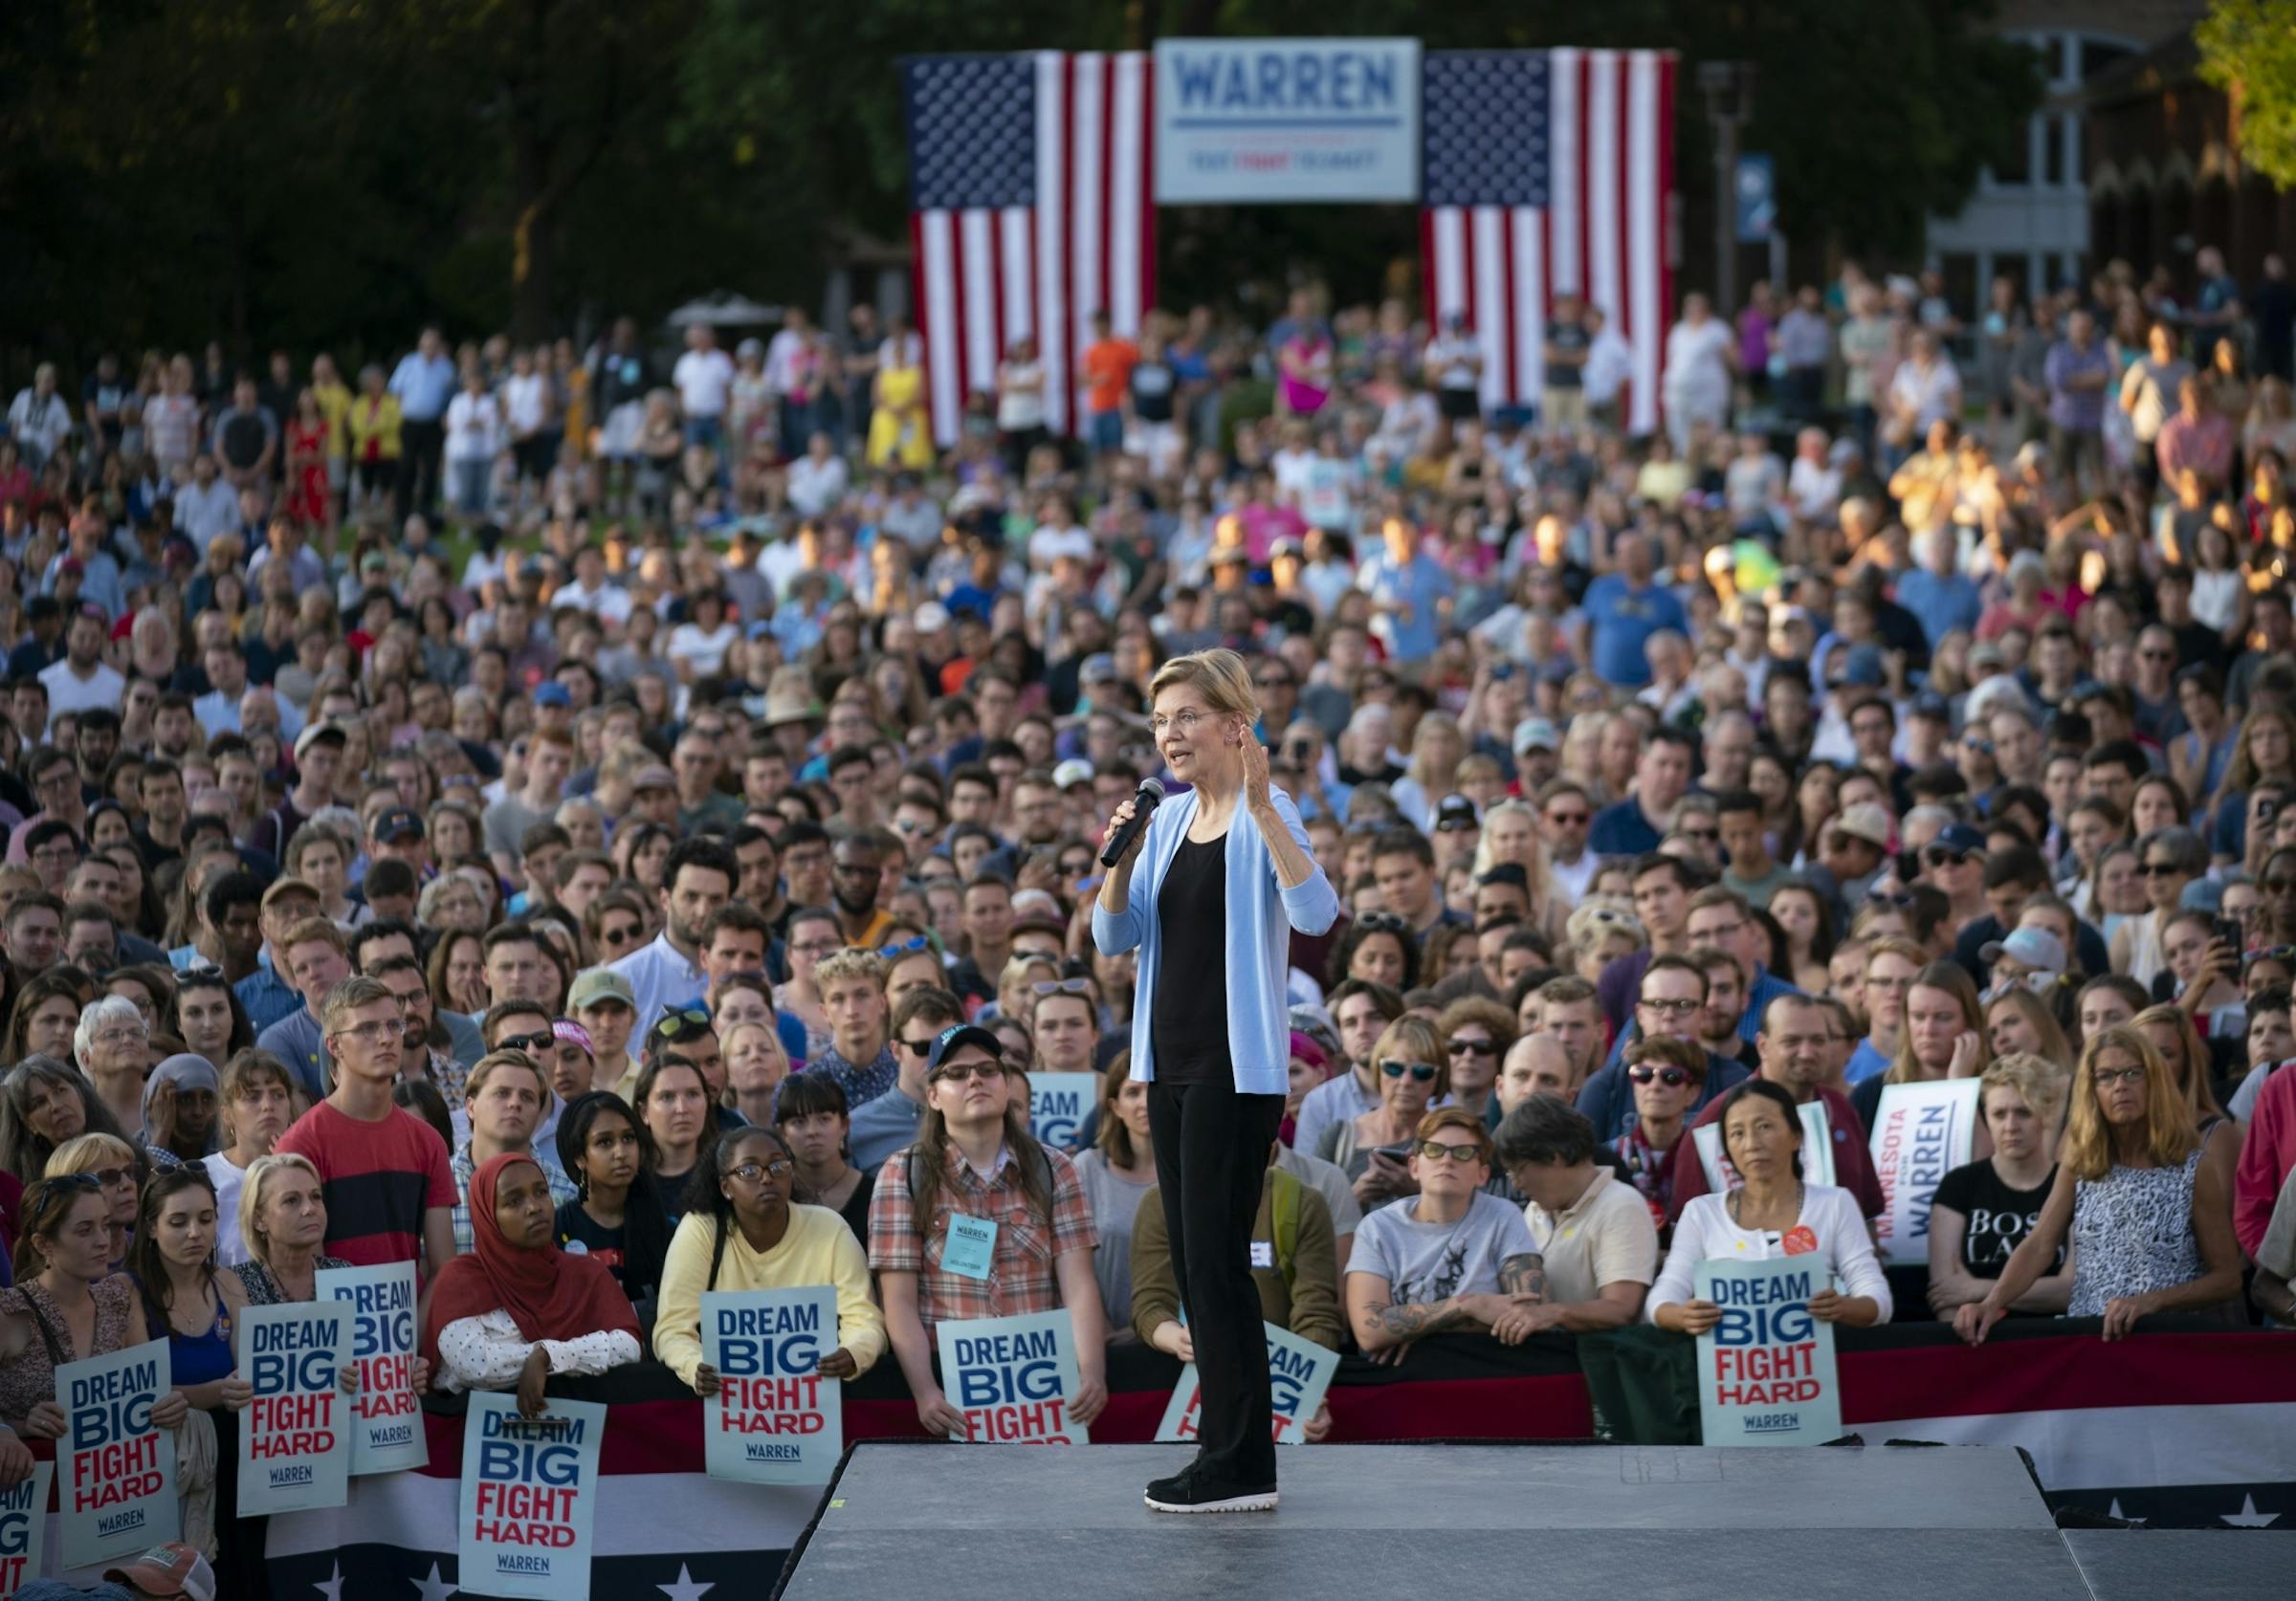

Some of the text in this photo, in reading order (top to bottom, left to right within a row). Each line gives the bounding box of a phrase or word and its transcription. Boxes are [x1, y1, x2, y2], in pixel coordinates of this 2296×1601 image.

[1172, 52, 1395, 109] WARREN
[1030, 1091, 1078, 1116] EAM
[1876, 1108, 1906, 1239] MINNESOTA
[1910, 1105, 1946, 1238] WARREN
[957, 1225, 988, 1239] WARREN
[1711, 1271, 1810, 1305] DREAM
[253, 1318, 339, 1352] DREAM
[353, 1310, 413, 1356] BIG
[718, 1304, 819, 1336] DREAM
[1714, 1303, 1814, 1346] BIG
[719, 1334, 820, 1375] BIG
[955, 1329, 1057, 1366] DREAM
[1715, 1342, 1817, 1381] FIGHT
[72, 1360, 157, 1410] DREAM
[253, 1350, 335, 1395] BIG
[352, 1353, 413, 1393] IGHT
[959, 1361, 1063, 1407] BIG
[351, 1391, 416, 1419] HARD
[720, 1373, 823, 1411] FIGHT
[1717, 1379, 1821, 1405] HARD
[73, 1393, 158, 1450] BIG
[252, 1393, 336, 1434] FIGHT
[482, 1410, 585, 1444] DREAM
[721, 1412, 825, 1435] HARD
[963, 1399, 1065, 1442] FIGHT
[1744, 1413, 1799, 1429] WARREN
[252, 1431, 335, 1459] HARD
[369, 1425, 412, 1444] WARREN
[746, 1443, 800, 1458] WARREN
[74, 1432, 159, 1487] FIGHT
[269, 1465, 313, 1484] WARREN
[479, 1440, 580, 1486] BIG
[75, 1471, 164, 1513] HARD
[476, 1482, 578, 1523] FIGHT
[98, 1508, 144, 1532] WARREN
[475, 1519, 576, 1547] HARD
[497, 1553, 550, 1571] WARREN
